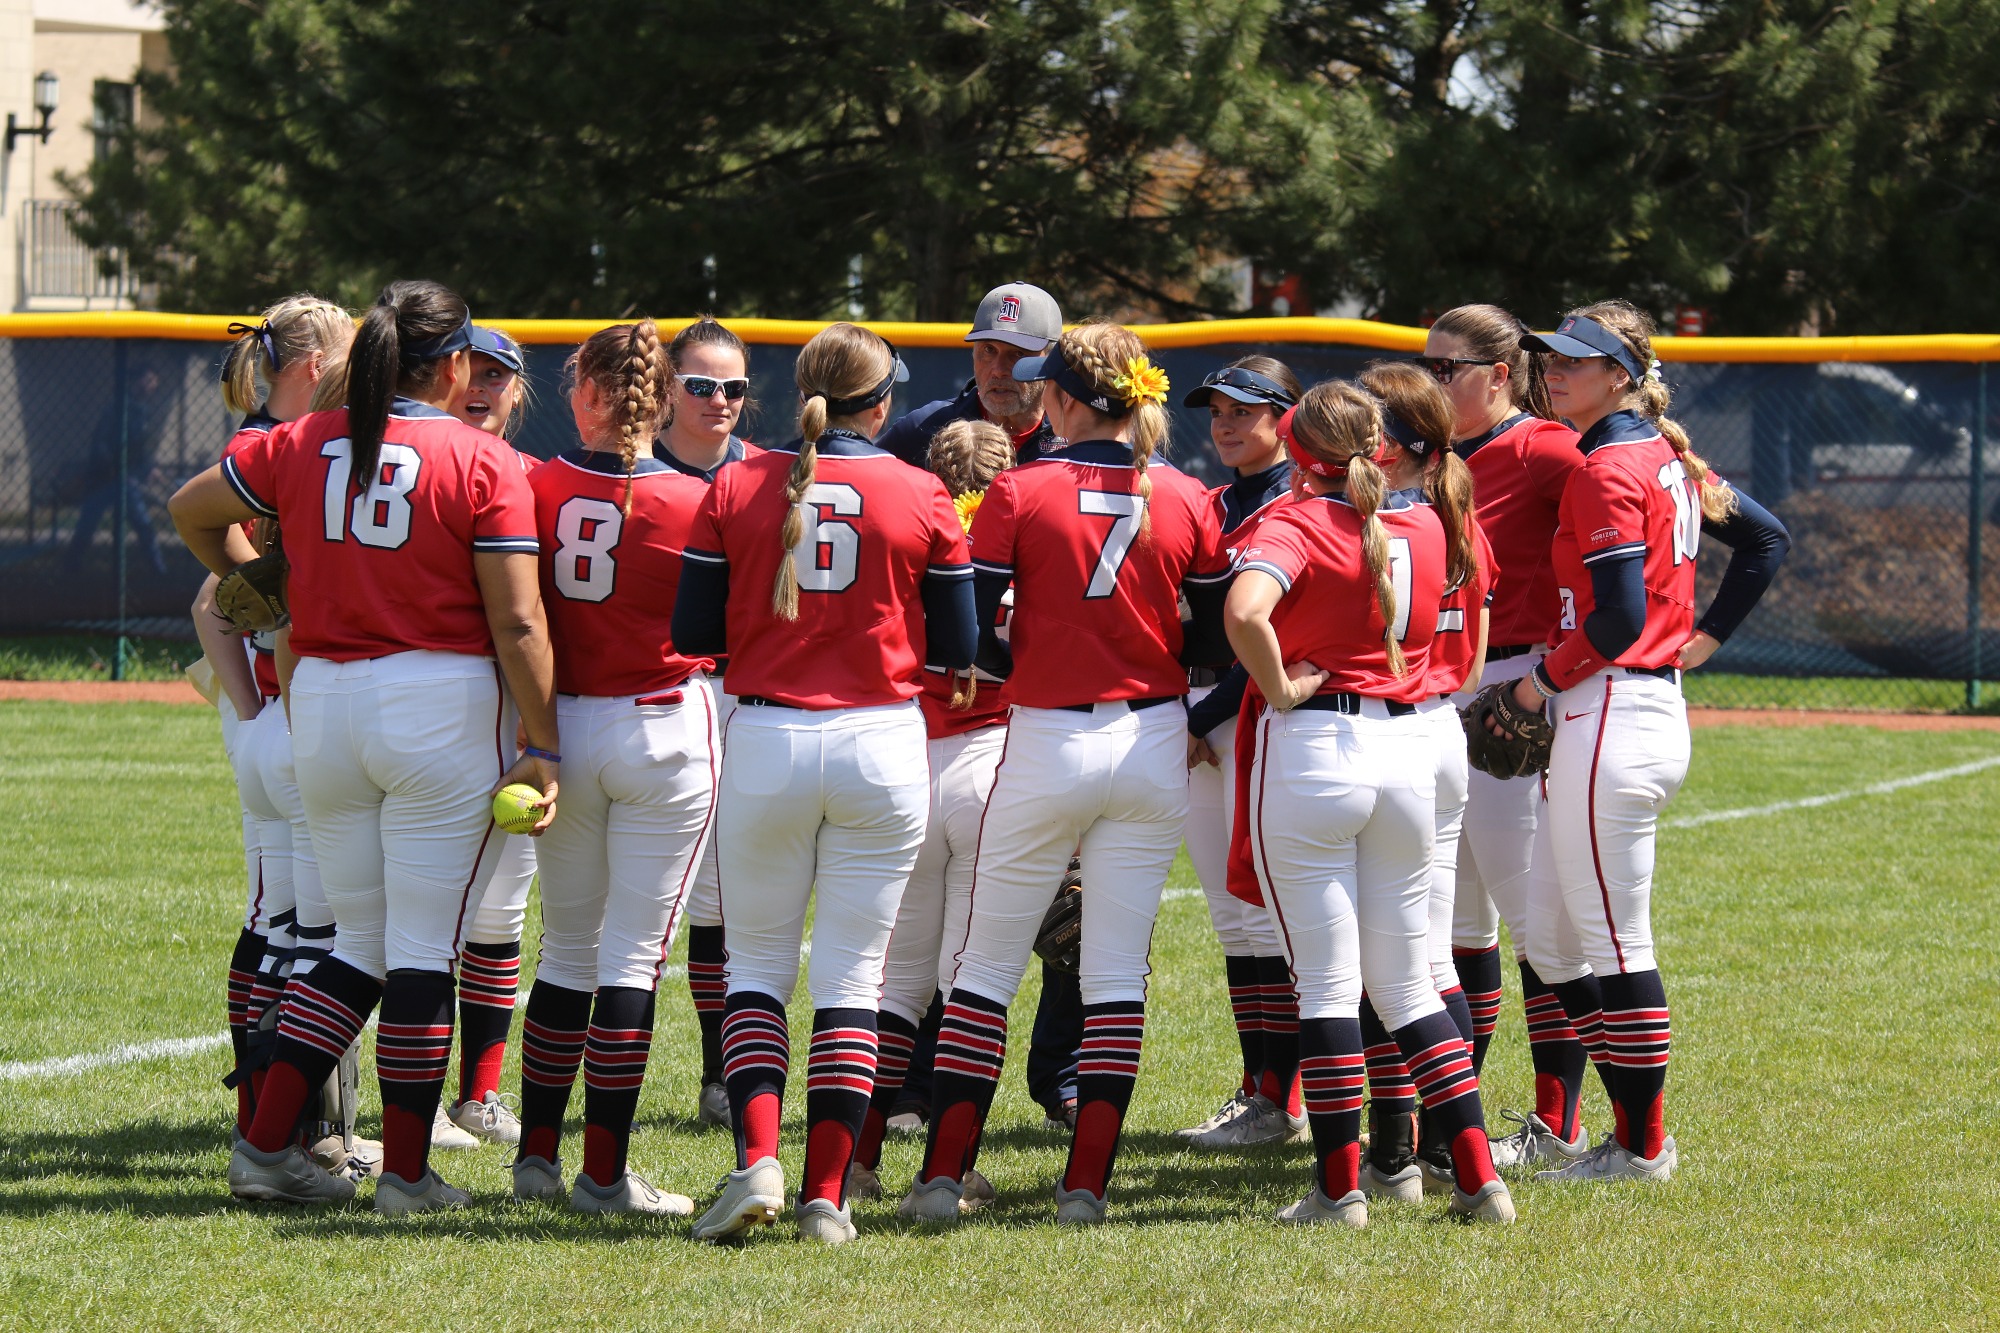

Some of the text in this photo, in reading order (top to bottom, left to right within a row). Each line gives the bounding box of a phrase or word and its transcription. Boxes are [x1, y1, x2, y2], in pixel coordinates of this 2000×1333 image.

[820, 428, 858, 438] ECHFIT
[319, 435, 423, 551] 18
[792, 481, 864, 594] 6
[1078, 488, 1145, 600] 7
[1590, 530, 1619, 541] HORIZON
[1656, 457, 1702, 567] 10
[553, 494, 625, 605] 8
